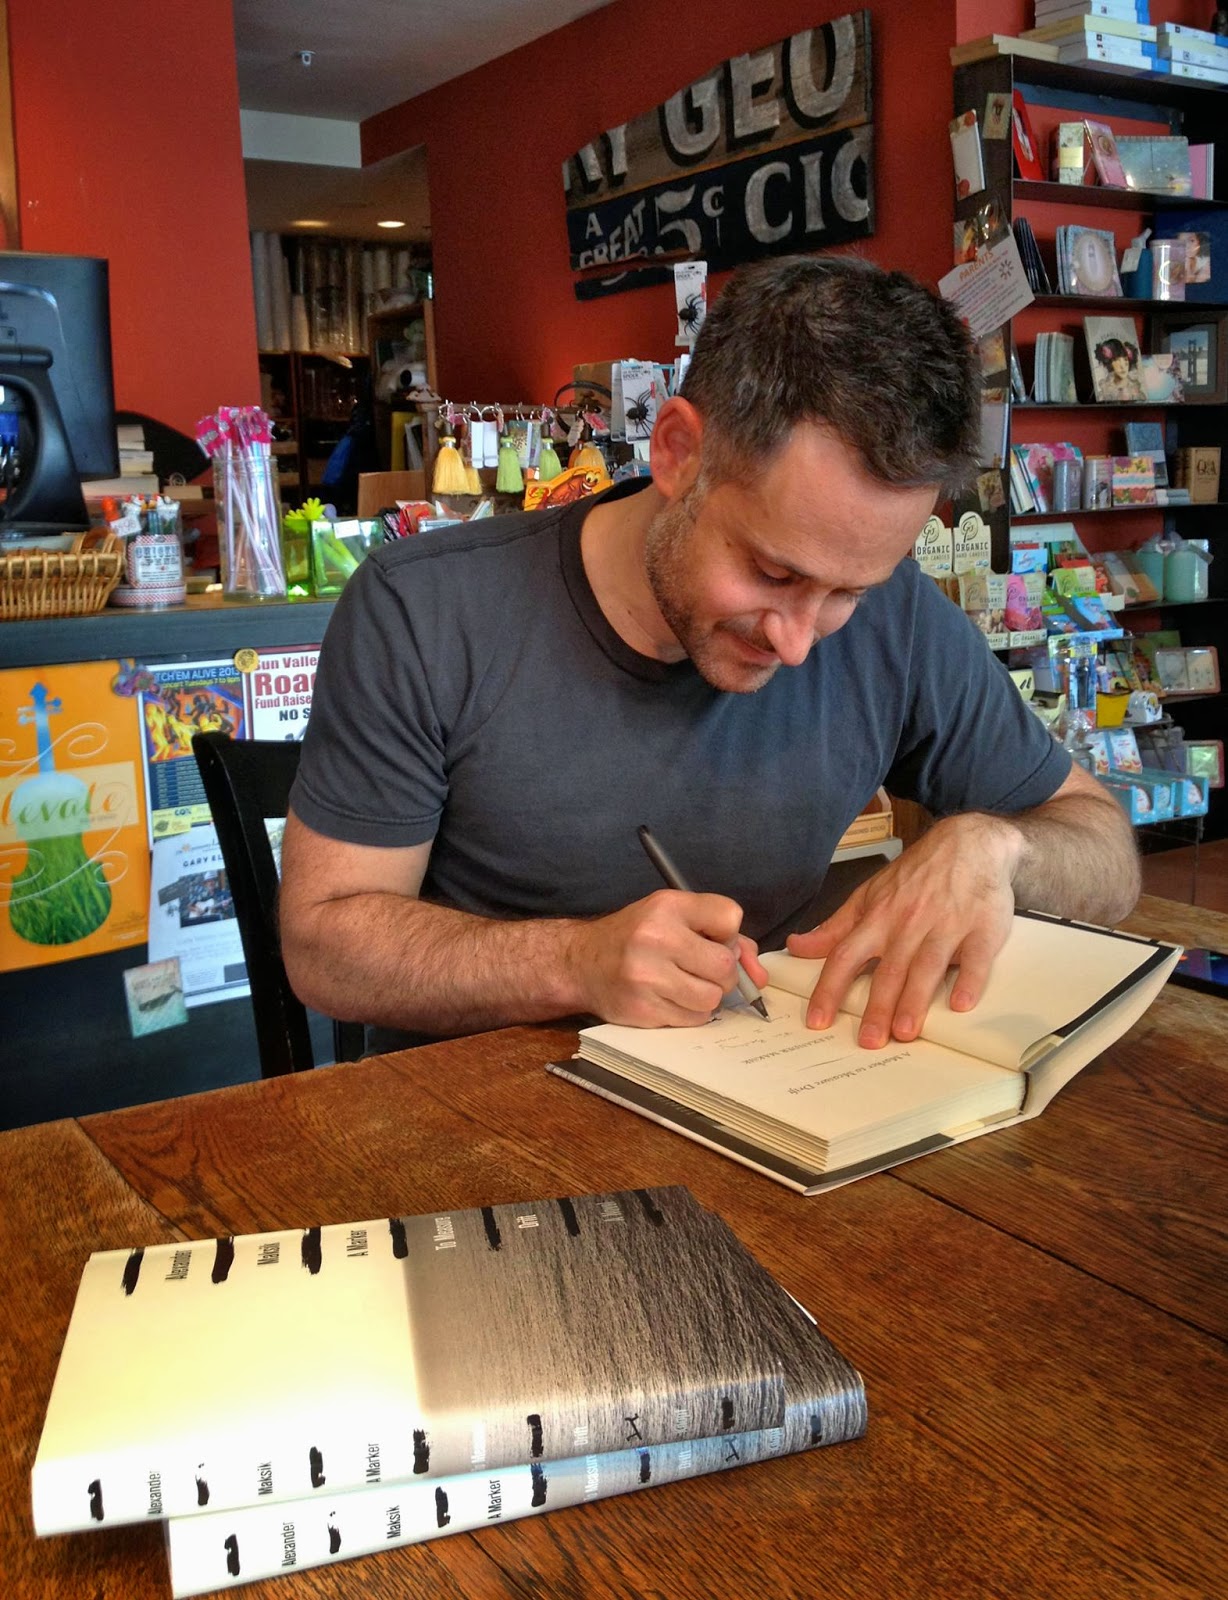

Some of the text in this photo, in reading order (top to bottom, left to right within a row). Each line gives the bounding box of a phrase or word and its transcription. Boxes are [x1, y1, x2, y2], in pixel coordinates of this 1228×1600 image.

[585, 211, 604, 240] A
[916, 544, 951, 556] ORGANIC
[955, 541, 989, 553] ORGANIC
[283, 655, 319, 669] Valle
[155, 670, 191, 683] TCH'EM
[192, 668, 217, 680] ALIVE
[254, 673, 316, 697] Roa
[255, 695, 313, 709] Fund Raise
[279, 710, 299, 722] NO
[182, 856, 209, 868] GARY
[346, 1229, 369, 1251] Marker
[164, 1249, 193, 1282] Alexander
[256, 1241, 281, 1266] Maksik
[366, 1442, 381, 1483] A Marker
[258, 1461, 274, 1496] Maksik
[147, 1470, 164, 1516] Alexander
[488, 1479, 501, 1520] A Marker
[387, 1504, 401, 1539] Maksik
[281, 1521, 297, 1568] Alexander
